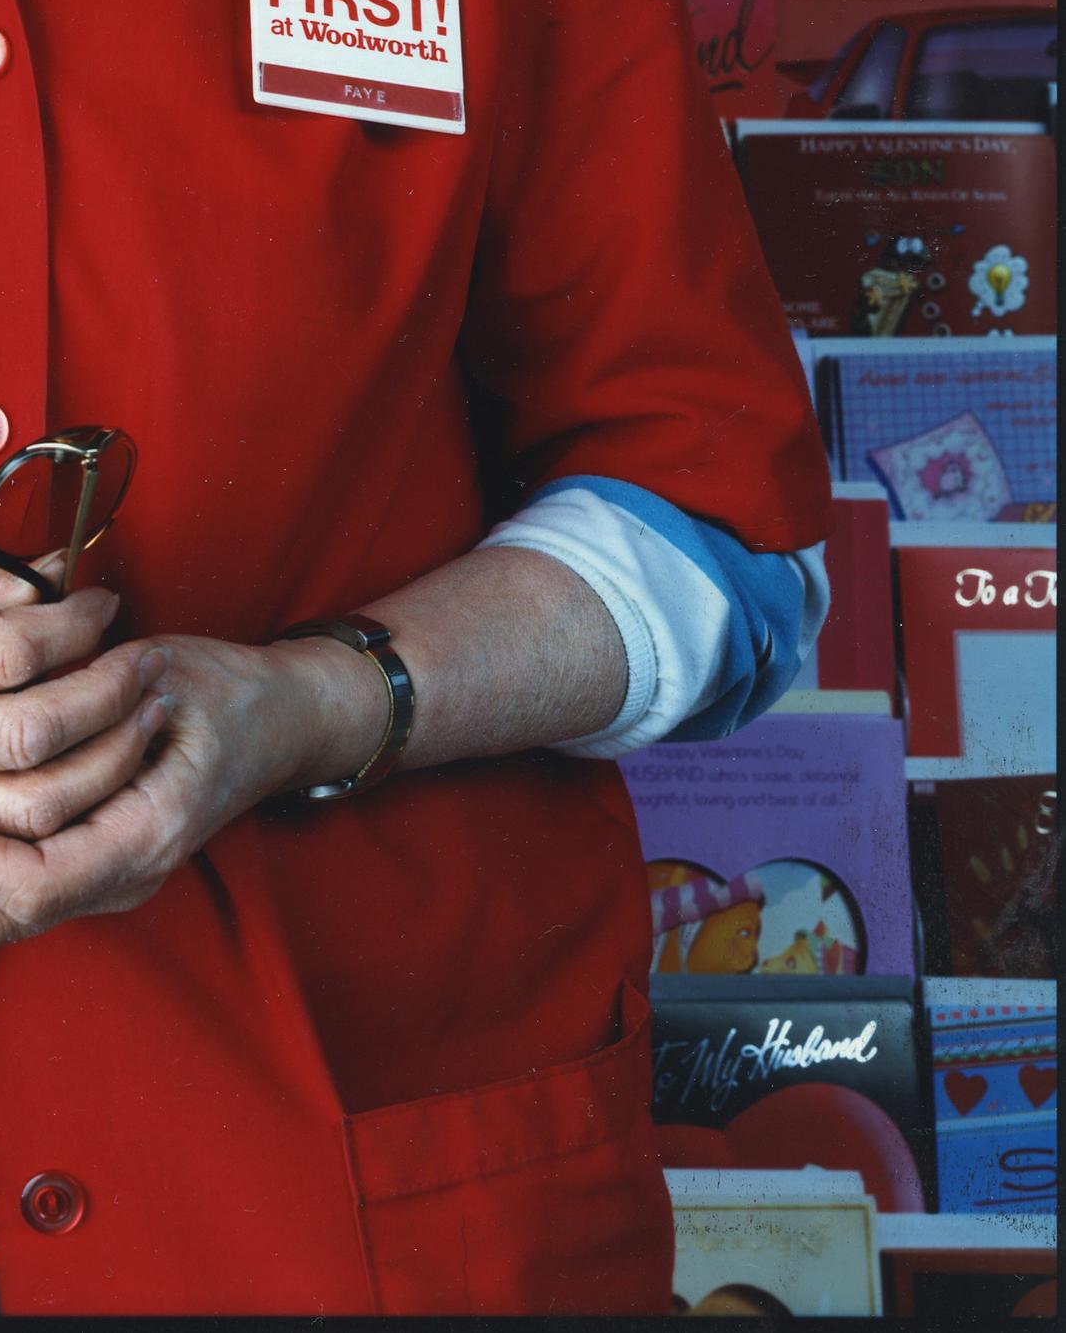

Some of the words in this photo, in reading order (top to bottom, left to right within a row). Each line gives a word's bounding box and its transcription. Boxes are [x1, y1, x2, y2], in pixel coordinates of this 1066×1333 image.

[270, 17, 294, 37] at
[300, 18, 449, 63] Woolworth
[344, 84, 387, 103] FAYE
[955, 568, 996, 608] To
[1002, 584, 1019, 606] a
[648, 744, 696, 762] Happy
[699, 745, 772, 760] Valentine's
[681, 1027, 740, 1112] My
[741, 1018, 878, 1081] Husband
